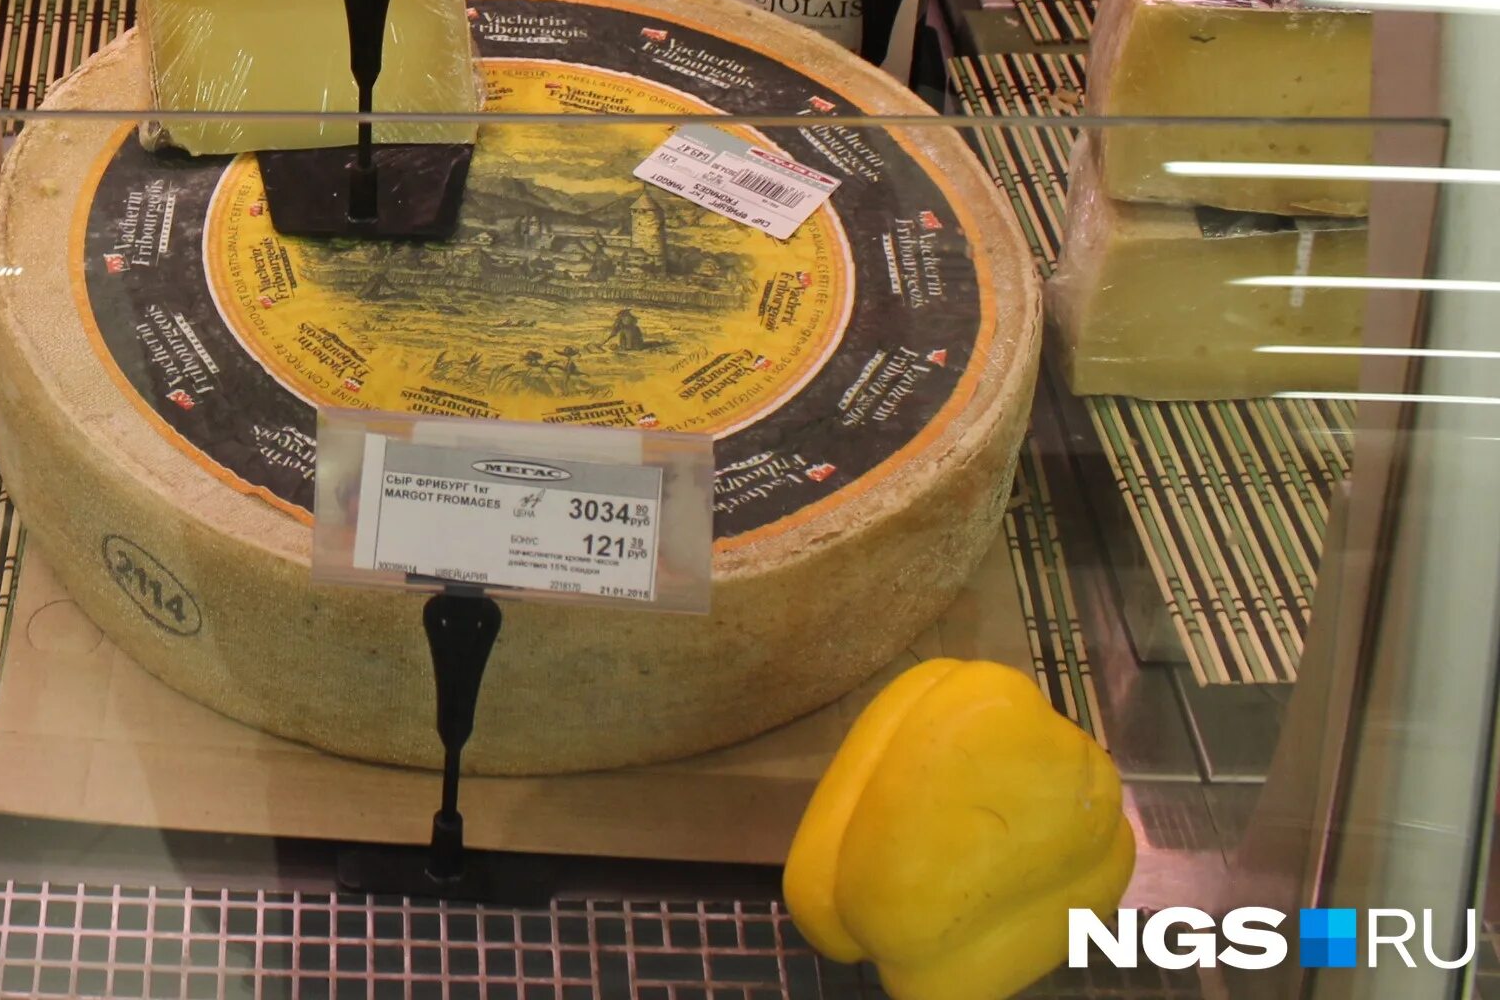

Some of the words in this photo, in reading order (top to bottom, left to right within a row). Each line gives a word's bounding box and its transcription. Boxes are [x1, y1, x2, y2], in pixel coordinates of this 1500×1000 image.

[640, 40, 755, 91] Fribourgeois
[666, 36, 751, 76] Vacherin
[650, 174, 685, 191] MARGOT
[693, 183, 739, 205] FROMAGES
[114, 191, 143, 250] Vacherin
[131, 179, 164, 267] Fribourgeois
[751, 218, 772, 229] СЫР
[136, 323, 184, 393] Vacherin
[148, 304, 215, 394] Fribourgeois
[484, 463, 562, 479] МЕГАС
[386, 475, 412, 487] СЫР
[416, 477, 469, 492] ФРИБУРГ
[473, 484, 490, 495] 1кг
[384, 489, 434, 502] MARGOT
[436, 493, 501, 509] FROMAGES
[568, 498, 630, 525] 3034
[629, 514, 650, 527] руб
[582, 534, 626, 558] 121
[627, 547, 647, 560] руб
[116, 551, 187, 622] 2114
